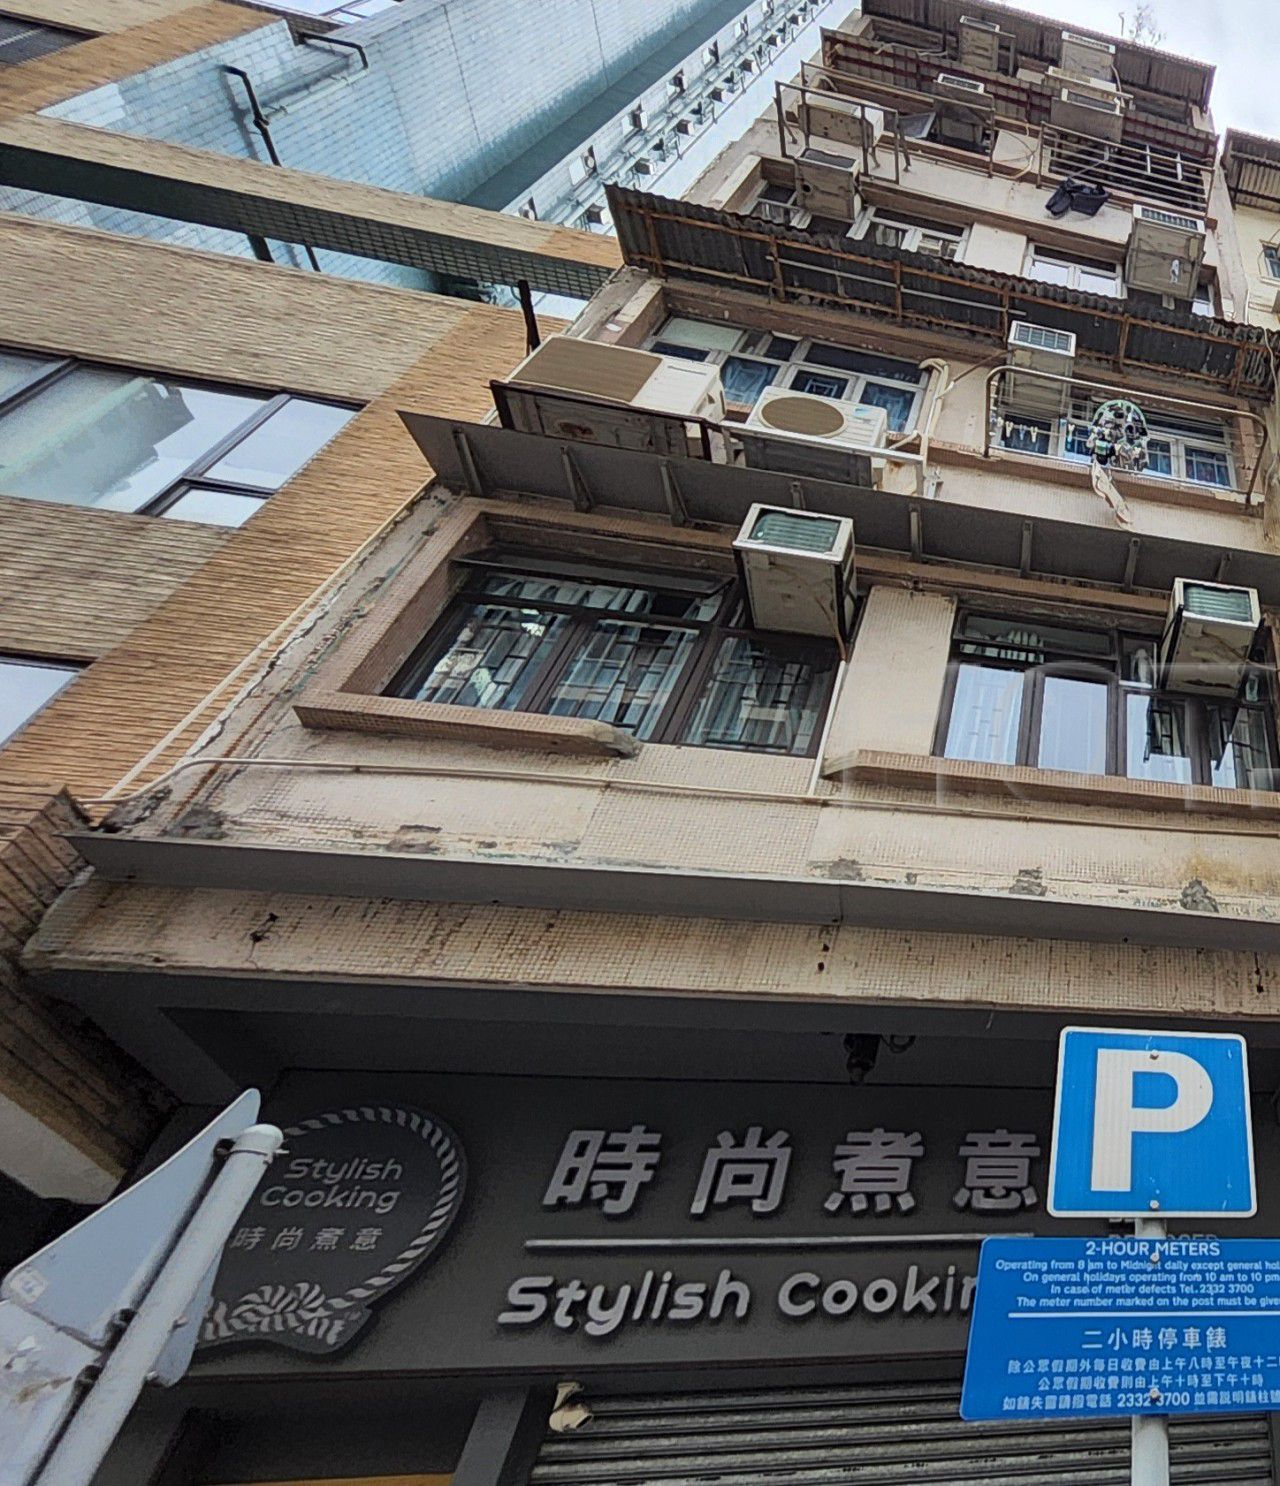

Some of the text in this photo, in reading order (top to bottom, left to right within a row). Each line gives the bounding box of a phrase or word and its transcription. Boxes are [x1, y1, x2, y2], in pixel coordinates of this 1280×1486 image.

[1090, 1047, 1214, 1192] P
[283, 1157, 403, 1185] Stylish
[541, 1124, 1041, 1216] 時尚煮意
[260, 1184, 400, 1214] Cooking
[230, 1226, 383, 1251] 時尚煮意
[1086, 1241, 1220, 1256] 2-HOUR METERS
[995, 1259, 1048, 1271] Operating
[1050, 1259, 1074, 1269] from
[1077, 1259, 1085, 1269] 8
[1088, 1261, 1103, 1269] am
[1106, 1260, 1118, 1269] to
[1164, 1260, 1188, 1271] daily
[1191, 1261, 1224, 1271] except
[1227, 1260, 1262, 1271] general
[1023, 1272, 1280, 1284] On general holidays operating from 10 am to 10 pm
[1050, 1284, 1061, 1294] In
[1063, 1286, 1089, 1294] case
[1091, 1284, 1102, 1294] of
[1105, 1285, 1136, 1294] meter
[1138, 1284, 1176, 1294] defects
[1200, 1284, 1225, 1294] 2332
[1228, 1284, 1254, 1294] 3700
[497, 1265, 978, 1337] Stylish Cooki
[1017, 1297, 1036, 1307] The
[1039, 1297, 1071, 1307] meter
[1073, 1297, 1113, 1306] number
[1116, 1296, 1154, 1306] marked
[1156, 1298, 1169, 1306] on
[1172, 1296, 1189, 1306] the
[1191, 1297, 1214, 1308] post
[1217, 1297, 1242, 1306] must
[1244, 1296, 1257, 1306] be
[1081, 1326, 1228, 1351] 二小時停車錶
[1117, 1392, 1152, 1408] 2332
[1155, 1391, 1190, 1407] 3700
